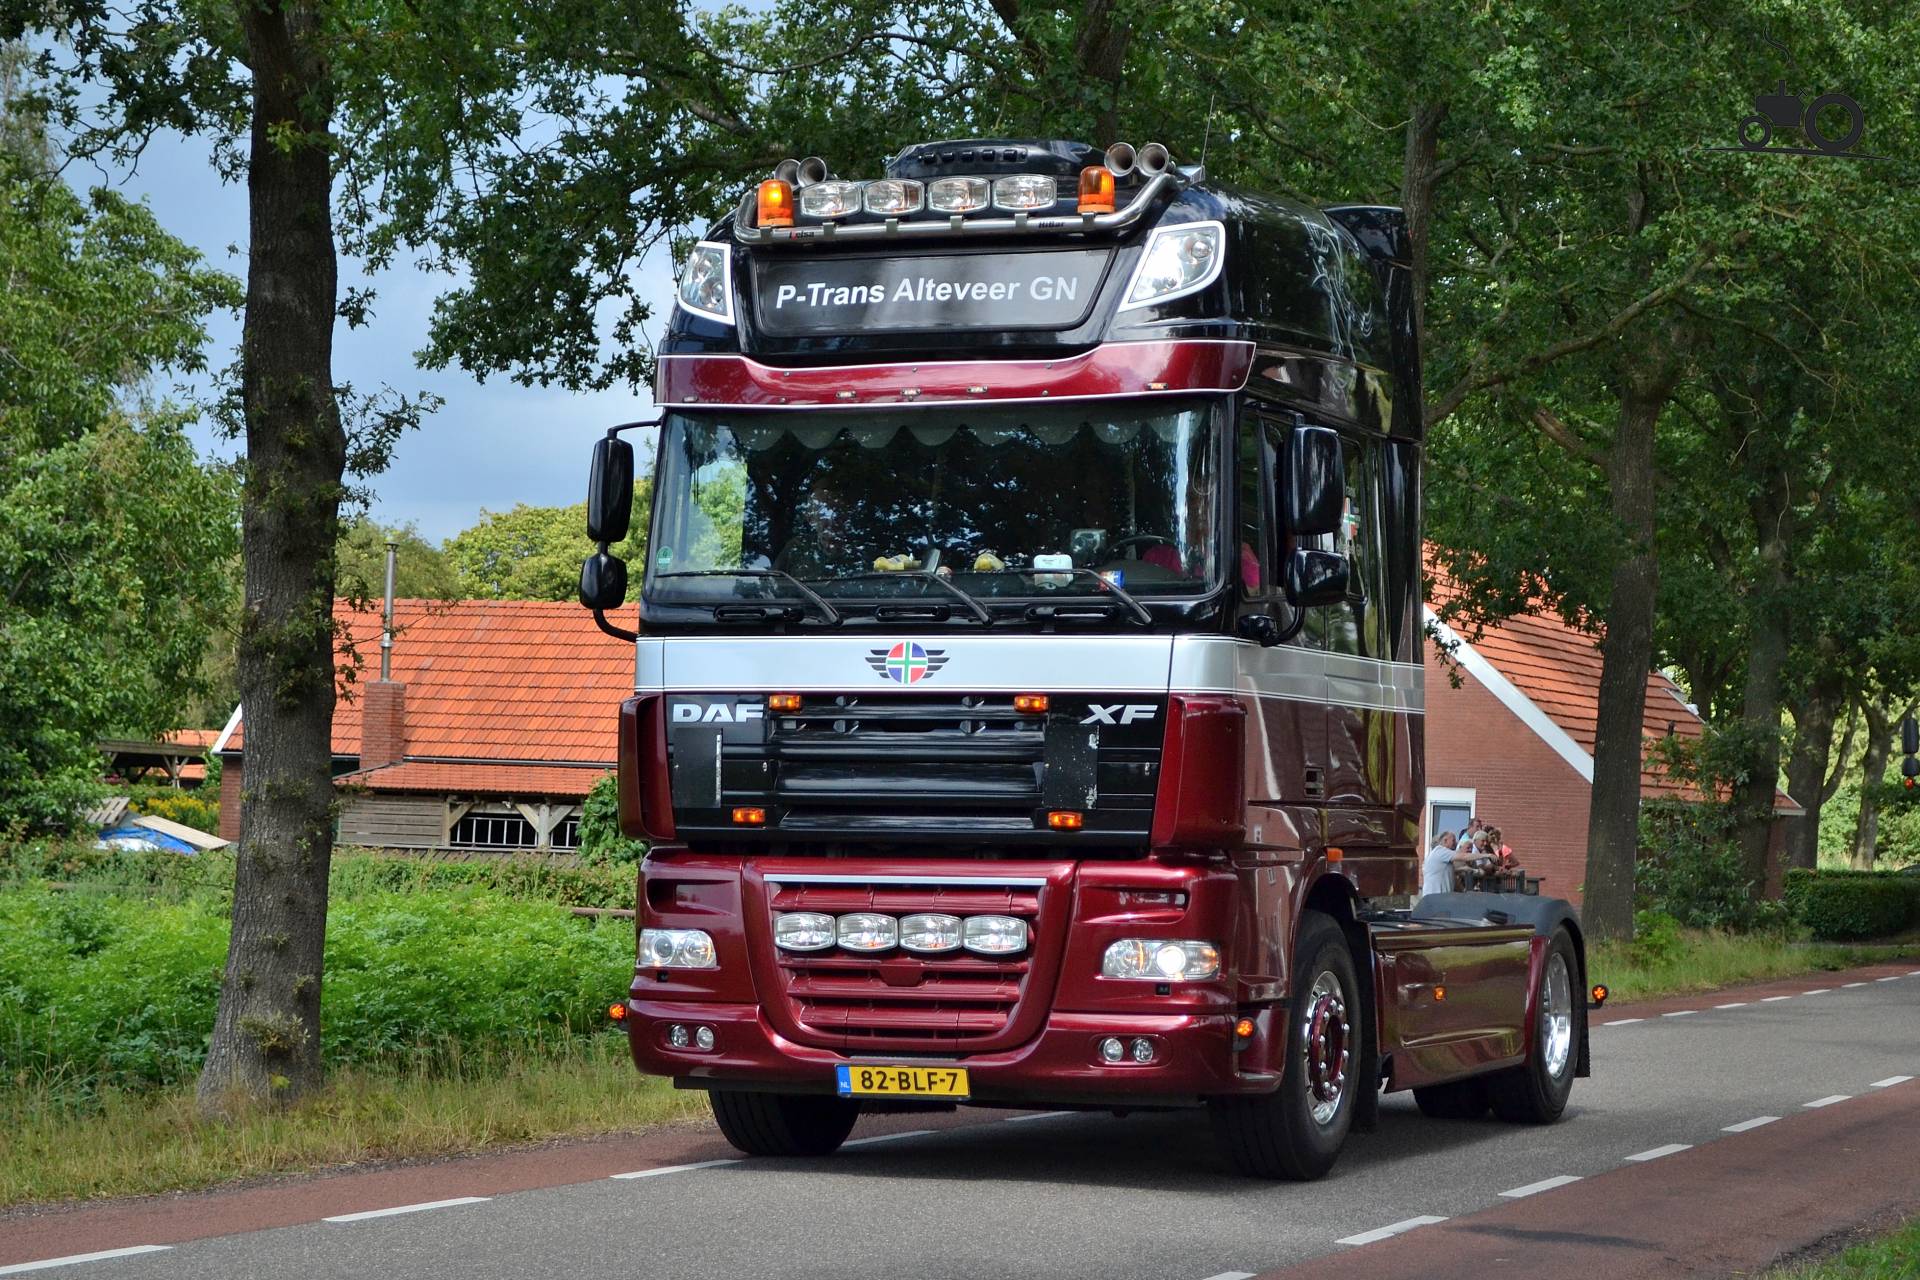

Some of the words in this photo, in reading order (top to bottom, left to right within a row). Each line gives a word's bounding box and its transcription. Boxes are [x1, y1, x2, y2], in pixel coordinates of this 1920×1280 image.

[776, 282, 885, 309] P-Trans
[892, 277, 1020, 302] Alteveer
[1029, 276, 1077, 301] GN
[672, 703, 764, 723] DAF
[1079, 704, 1158, 724] XF
[840, 1081, 850, 1089] NL
[860, 1070, 958, 1092] 82-BLF-7
